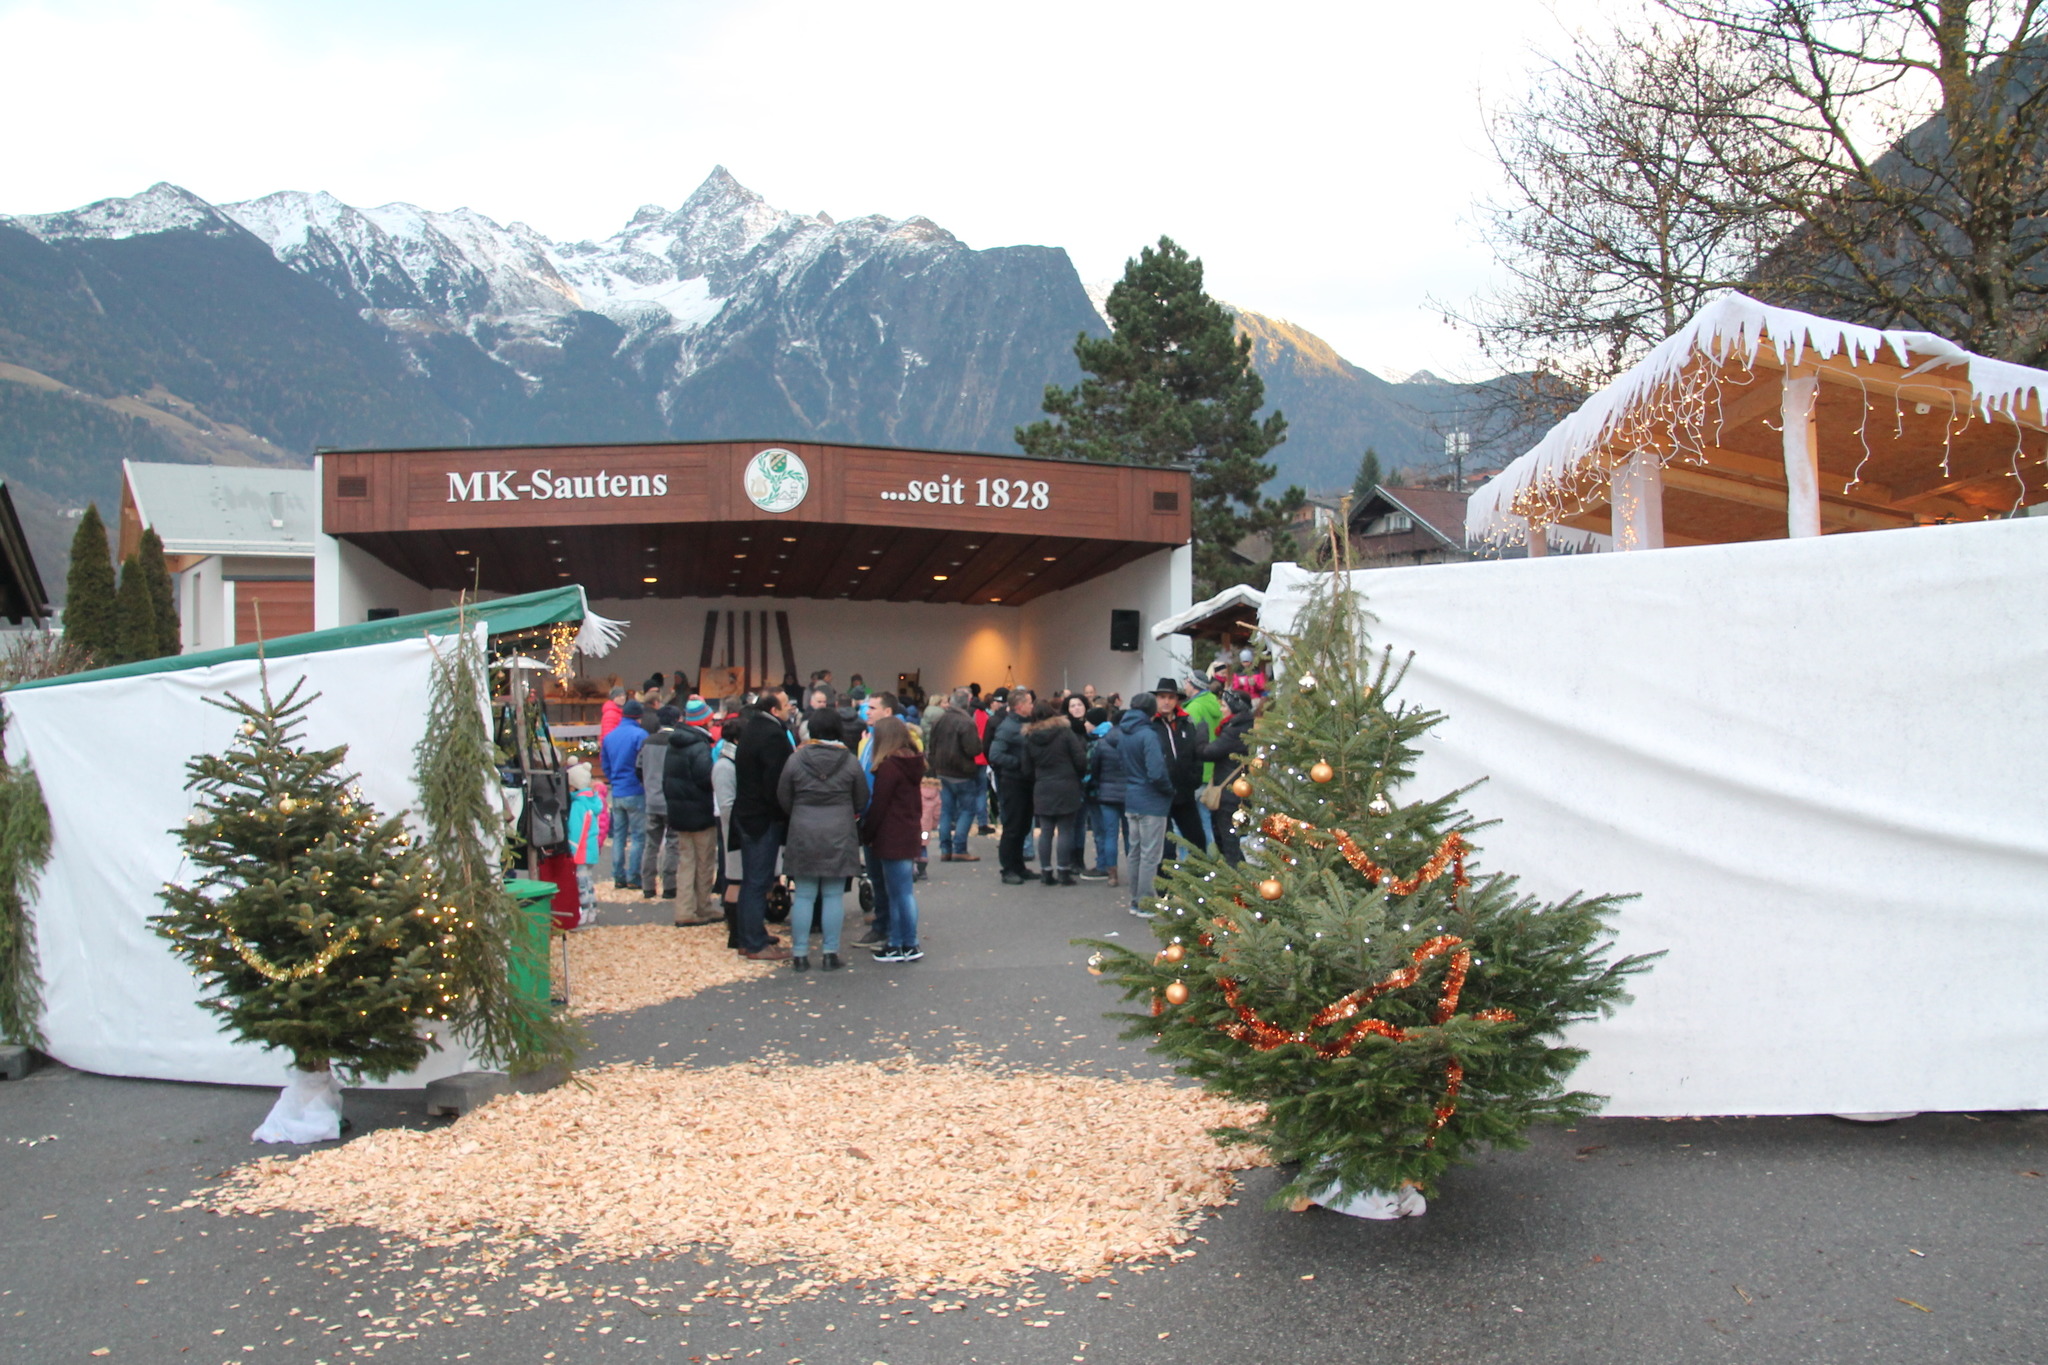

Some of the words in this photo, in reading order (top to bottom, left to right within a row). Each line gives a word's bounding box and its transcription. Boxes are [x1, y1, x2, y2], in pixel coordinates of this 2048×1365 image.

[446, 469, 668, 502] MK-Sautens
[880, 474, 965, 505] ...seit
[975, 477, 1049, 510] 1828
